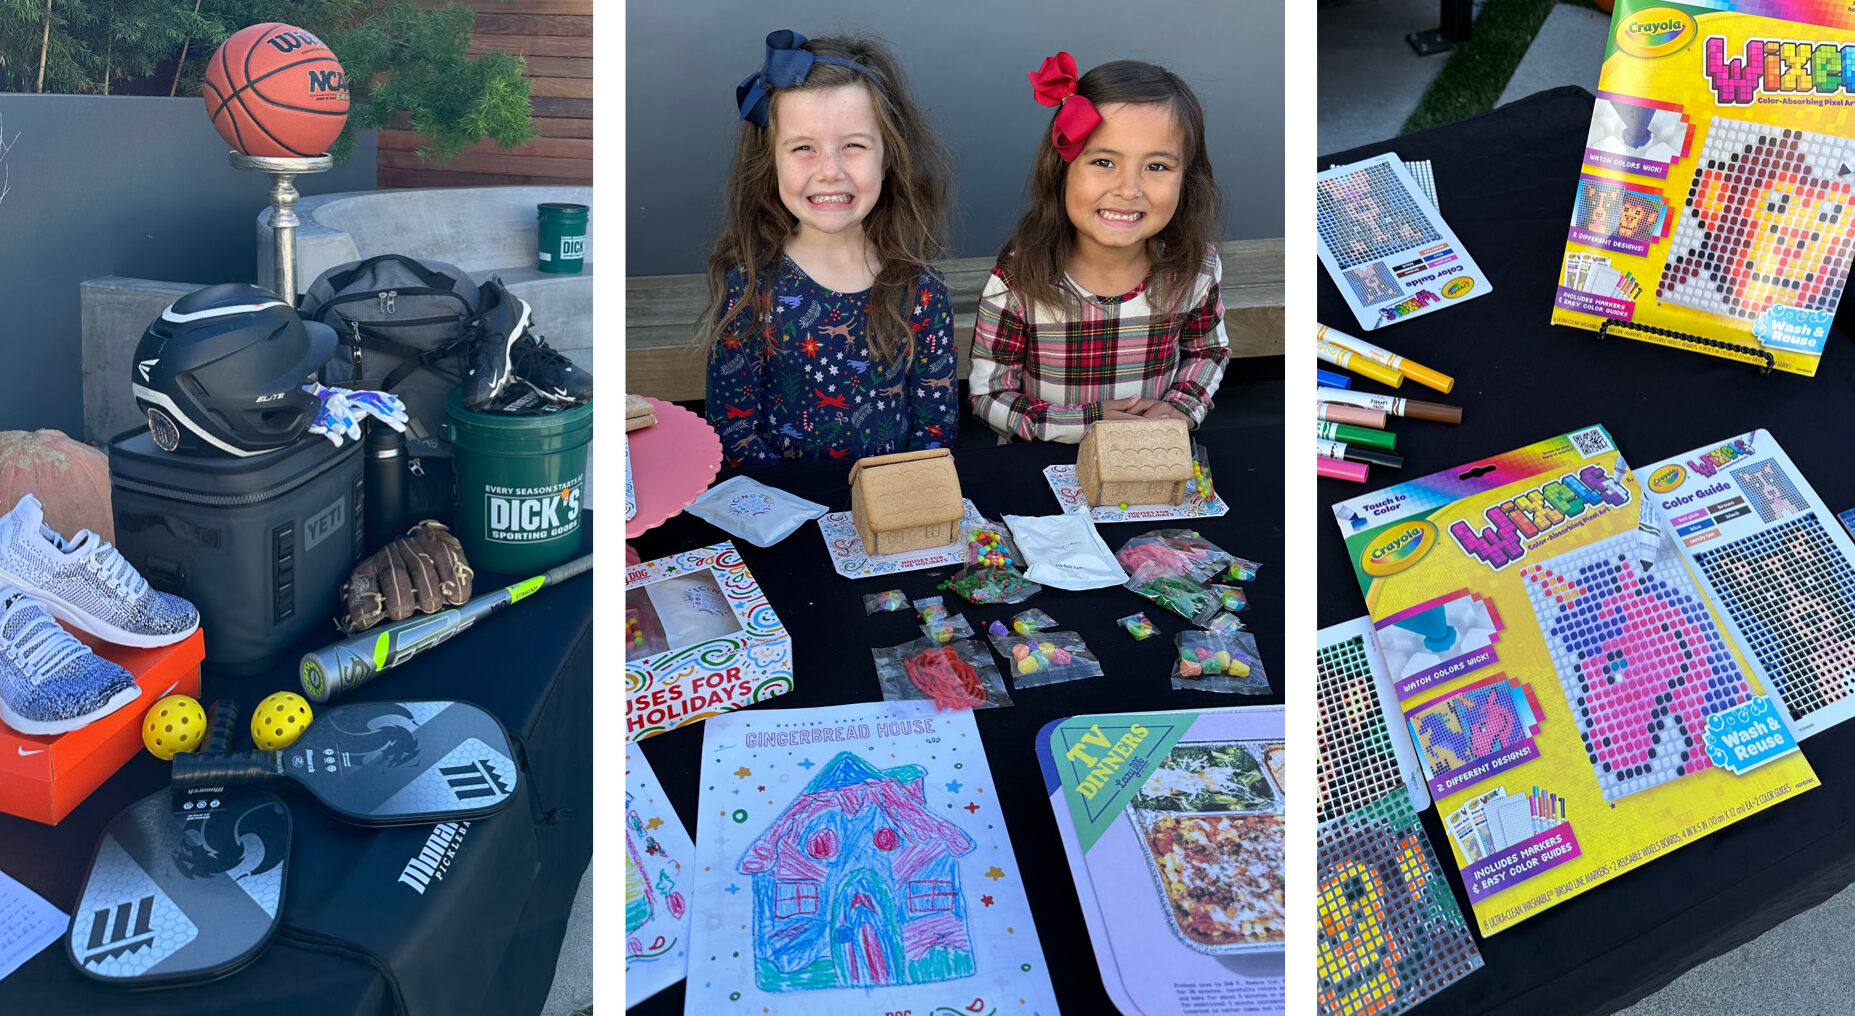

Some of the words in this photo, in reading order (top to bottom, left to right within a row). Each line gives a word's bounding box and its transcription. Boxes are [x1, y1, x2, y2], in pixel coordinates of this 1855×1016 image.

[1628, 18, 1682, 34] Crayola
[1705, 36, 1855, 105] Wixel
[1757, 97, 1824, 107] Color-Absorbing
[1824, 98, 1840, 106] Pixel
[1589, 153, 1612, 165] WATCH
[1613, 159, 1641, 169] COLORS
[1642, 164, 1662, 173] WICK!
[1578, 234, 1611, 246] DIFFERENT
[1613, 239, 1644, 252] DESIGNS!
[1405, 274, 1436, 288] Guide
[1437, 265, 1464, 278] Color
[1563, 292, 1593, 304] INCLUDES
[1595, 300, 1626, 310] MARKERS
[1564, 298, 1581, 308] EASY
[1583, 304, 1604, 313] COLOR
[1605, 308, 1629, 317] GUIDES
[1771, 319, 1812, 336] Wash
[1812, 326, 1825, 338] &
[1771, 331, 1817, 347] Reuse
[255, 392, 286, 403] ELITE
[1687, 439, 1755, 478] Wixels
[485, 484, 514, 495] EVERY
[515, 486, 552, 495] SEASON
[553, 478, 578, 492] STARTS
[1653, 468, 1677, 485] Crayola
[1362, 498, 1394, 512] Touch
[1661, 494, 1694, 510] Color
[1695, 482, 1732, 499] Guide
[308, 503, 341, 541] YETI
[490, 488, 580, 531] DICK'S
[1373, 504, 1401, 516] Color
[1450, 465, 1631, 570] Wixels
[1724, 510, 1740, 520] black
[492, 530, 547, 540] SPORTING
[551, 519, 578, 536] GOODS
[1527, 519, 1583, 551] Color-Absorbing
[1582, 513, 1599, 524] Pixel
[1599, 506, 1611, 517] Art
[1371, 527, 1421, 559] Crayola
[901, 557, 929, 565] HOUSES
[917, 557, 949, 567] HOLIDAYS
[629, 569, 649, 580] DOG
[692, 666, 742, 694] FOR
[1403, 675, 1432, 692] WATCH
[1434, 662, 1465, 679] COLORS
[1466, 652, 1490, 666] WICK!
[745, 724, 871, 748] GINGERBREAD
[876, 719, 936, 738] HOUSE
[1721, 720, 1769, 748] Wash
[1766, 716, 1781, 730] &
[1065, 723, 1112, 769] TV
[1733, 733, 1785, 761] Reuse
[1075, 723, 1149, 800] DINNERS
[1436, 784, 1444, 792] 2
[1446, 763, 1491, 788] DIFFERENT
[1491, 746, 1532, 769] DESIGNS!
[1115, 766, 1141, 788] Lazy
[397, 822, 459, 895] Mona
[435, 821, 472, 881] PICKLEBA
[1473, 854, 1518, 880] INCLUDES
[1520, 834, 1563, 858] MARKERS
[1483, 921, 1489, 931] 8
[1488, 905, 1523, 929] ULTRA-CLEAN
[1554, 883, 1574, 897] BROAD
[1573, 876, 1585, 889] LINE
[1584, 864, 1610, 883] MARKERS
[1611, 861, 1617, 872] 2
[1617, 850, 1643, 869] REUSABLE
[1641, 841, 1661, 857] WIXELS
[1660, 832, 1683, 849] BOARDS,
[1682, 830, 1686, 838] 4
[1686, 828, 1693, 837] IN
[1692, 825, 1698, 834] X
[1697, 823, 1703, 832] 5
[1701, 820, 1708, 830] IN
[1707, 816, 1717, 828] (10
[1716, 814, 1725, 823] cm
[1724, 811, 1729, 820] X
[1729, 804, 1736, 815] 12
[1746, 800, 1753, 810] EA
[1754, 797, 1760, 807] 2
[1759, 790, 1774, 805] COLOR
[1774, 783, 1792, 798] GUIDES
[1481, 872, 1506, 890] EASY
[1509, 858, 1540, 877] COLOR
[1541, 842, 1573, 862] GUIDES
